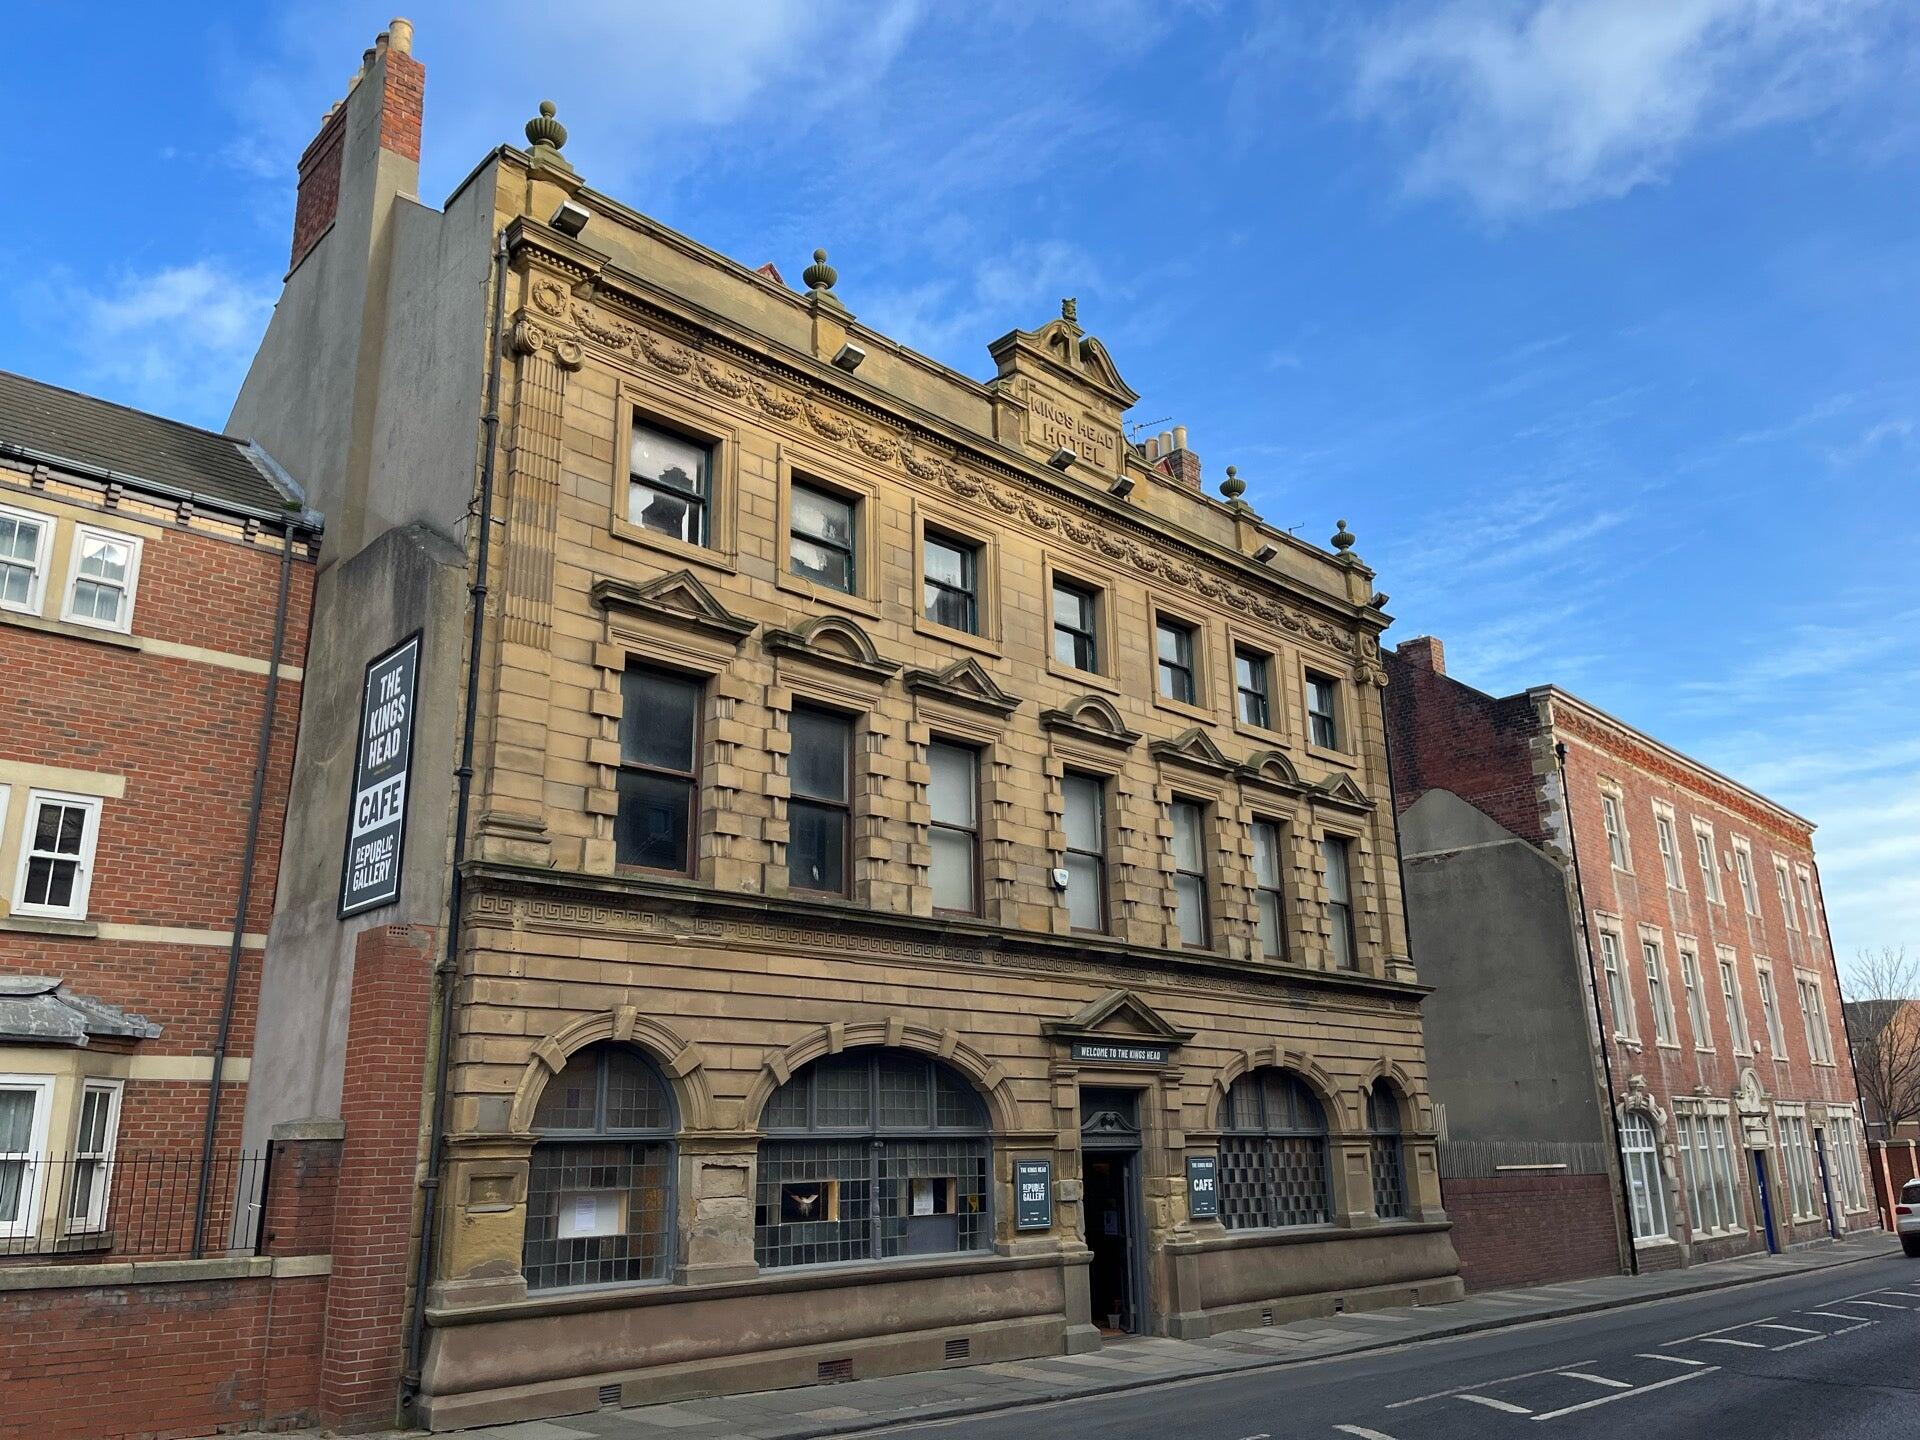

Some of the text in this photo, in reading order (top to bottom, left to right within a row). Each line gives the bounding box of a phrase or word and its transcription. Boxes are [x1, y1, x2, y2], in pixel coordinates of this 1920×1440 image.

[1043, 423, 1106, 468] HOTEL
[1077, 419, 1114, 449] HEAD
[380, 665, 403, 703] THE
[369, 693, 406, 739] KINGS
[368, 727, 401, 769] HEAD
[358, 780, 402, 829] CAFE
[355, 834, 394, 866] REPUBLIC
[352, 858, 392, 892] GALLERY
[1081, 1046, 1161, 1061] WELCOME TO THE KINGS HEAD
[1022, 1183, 1045, 1193] REPUBLIC
[1022, 1192, 1045, 1201] GALLERY
[1193, 1178, 1214, 1192] CAFE
